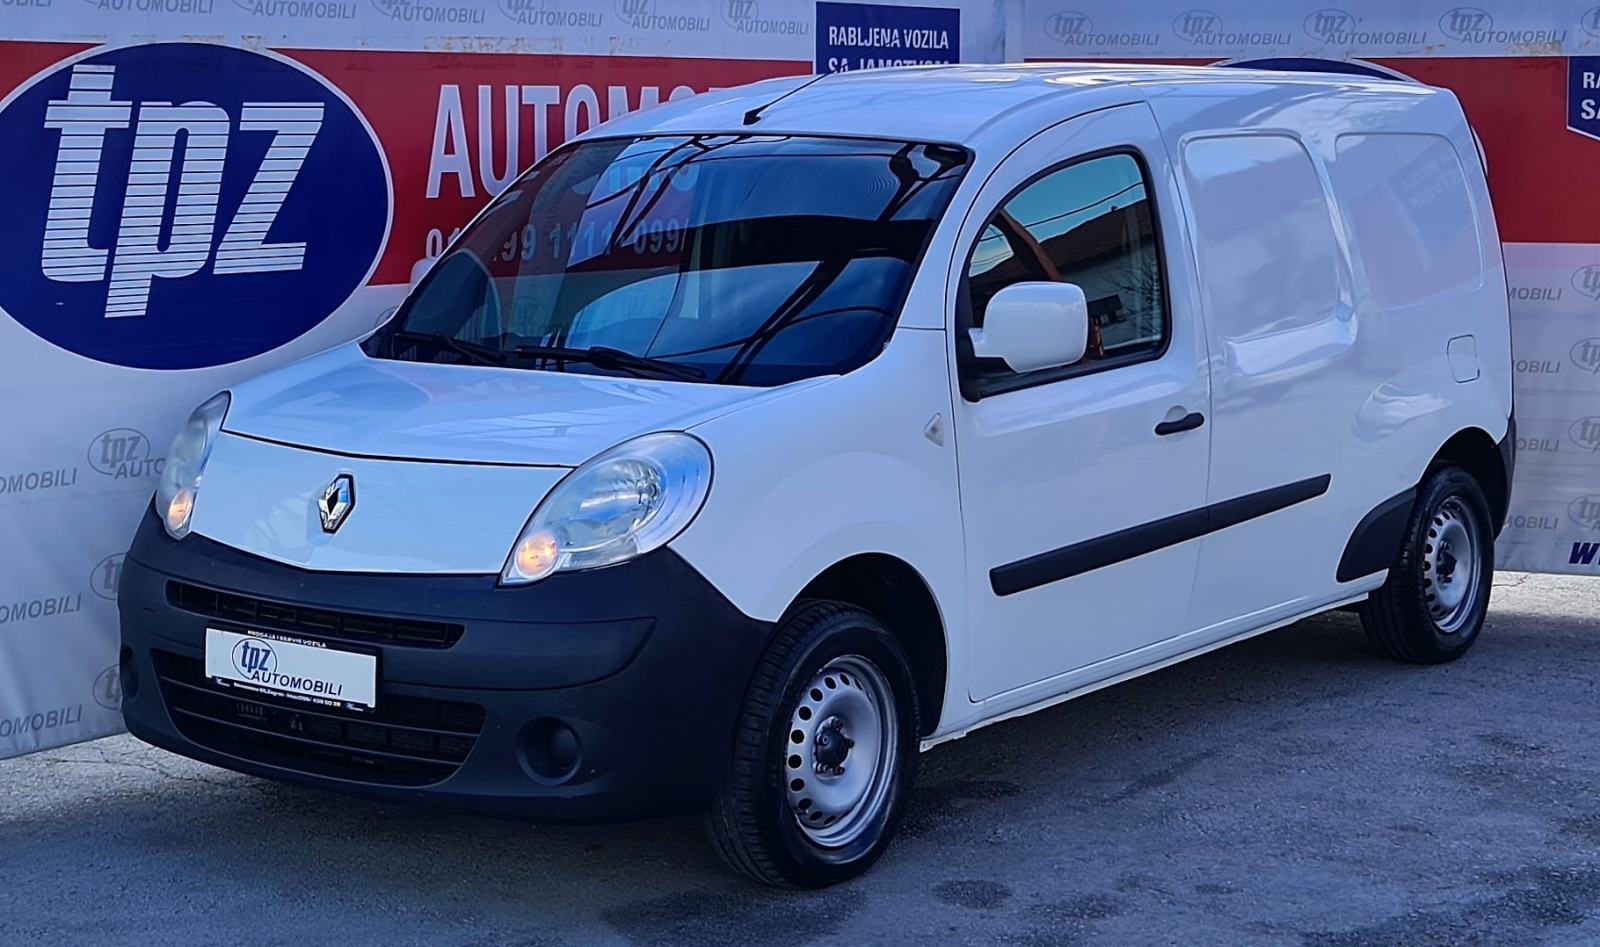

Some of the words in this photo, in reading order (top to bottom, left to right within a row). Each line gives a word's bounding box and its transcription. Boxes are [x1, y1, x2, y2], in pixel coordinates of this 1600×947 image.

[251, 0, 357, 20] AUTOMOBILI
[390, 5, 486, 24] AUTOMOBILI
[516, 10, 604, 27] AUTOMOBILI
[631, 15, 710, 32] AUTOMOBILI
[736, 20, 809, 35] AUTOMOBILI
[1054, 14, 1086, 38] tpz
[1182, 13, 1216, 37] tpz
[1313, 12, 1348, 37] tpz
[1450, 10, 1485, 36] tpz
[828, 26, 901, 48] RABLJENA
[903, 29, 949, 50] VOZILA
[1064, 33, 1160, 47] AUTOMOBILI
[1193, 33, 1292, 46] AUTOMOBILI
[1325, 32, 1427, 45] AUTOMOBILI
[1461, 30, 1568, 44] AUTOMOBILI
[41, 64, 326, 319] tpz
[100, 433, 142, 469] tpz
[241, 641, 271, 673] tpz
[250, 671, 343, 696] AUTOMOBILI
